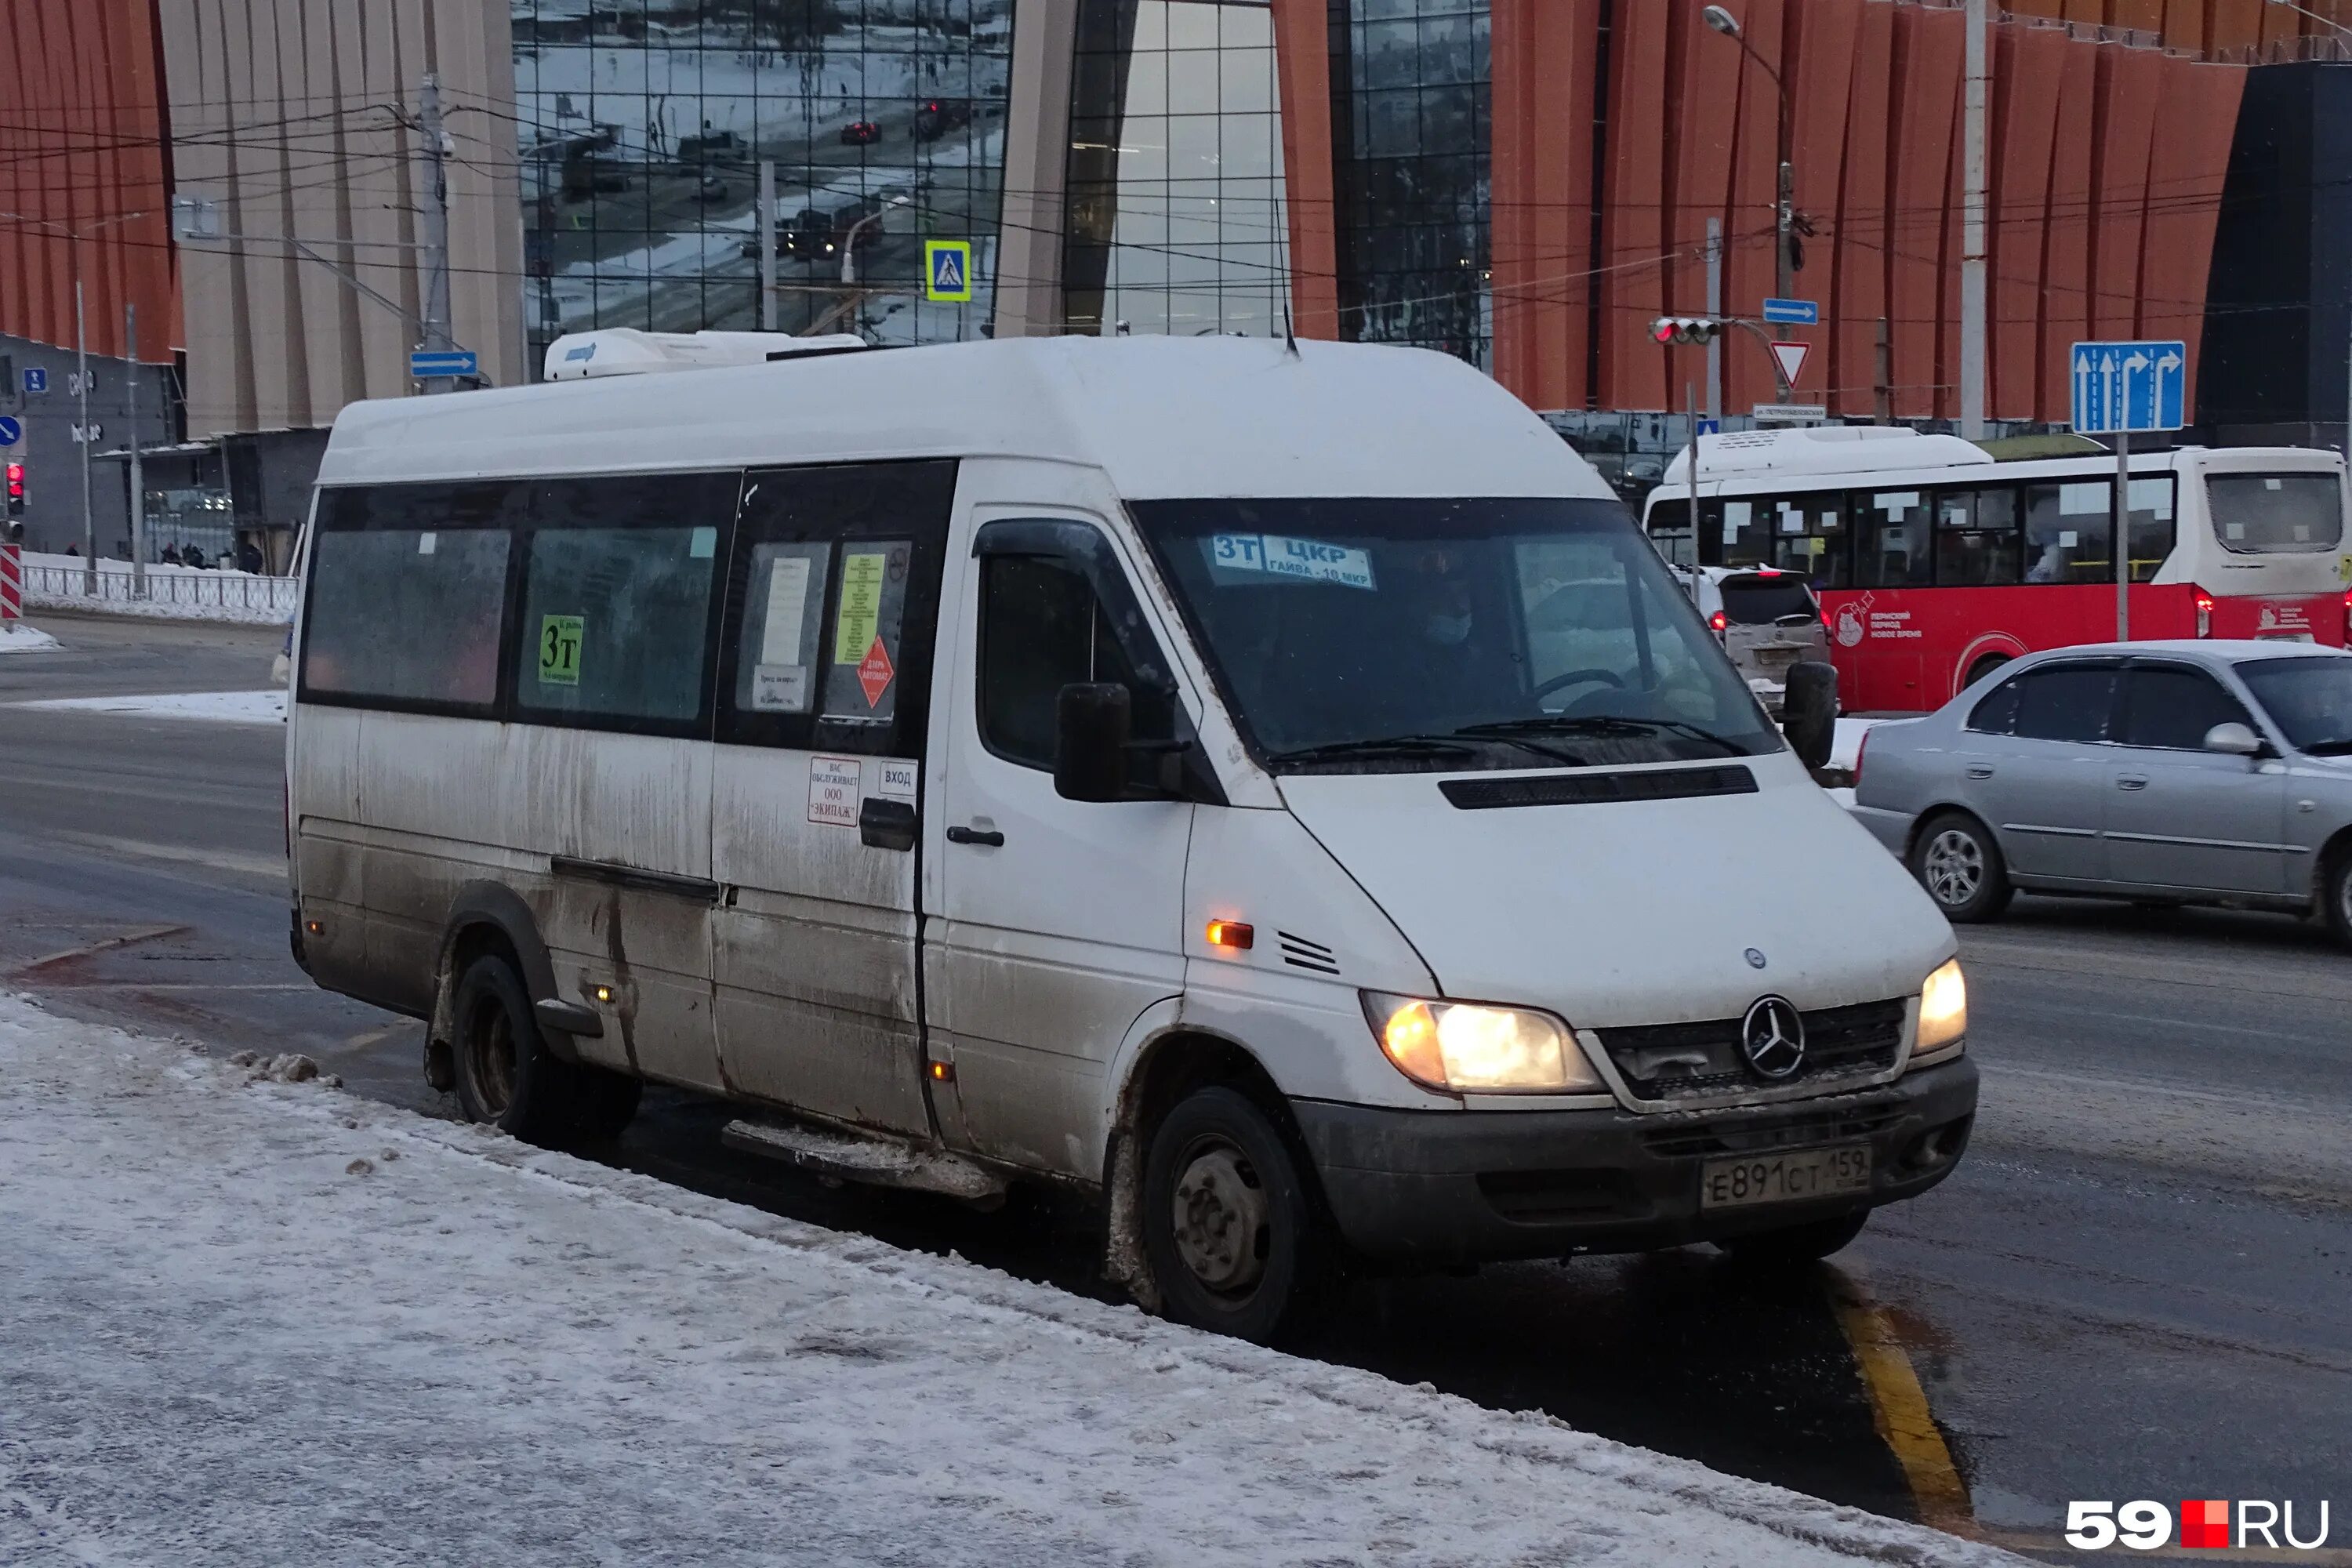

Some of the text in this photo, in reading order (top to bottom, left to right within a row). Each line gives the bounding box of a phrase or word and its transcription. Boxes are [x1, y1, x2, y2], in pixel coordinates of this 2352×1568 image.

[1285, 539, 1347, 564] ЦКР
[1269, 560, 1312, 576] ГАЙВА
[1323, 568, 1339, 580] 10
[829, 763, 841, 772] ВАС
[811, 773, 858, 786] ОБСЛУЖИВАЕТ
[885, 771, 911, 787] ВХОД
[824, 788, 842, 800] ООО
